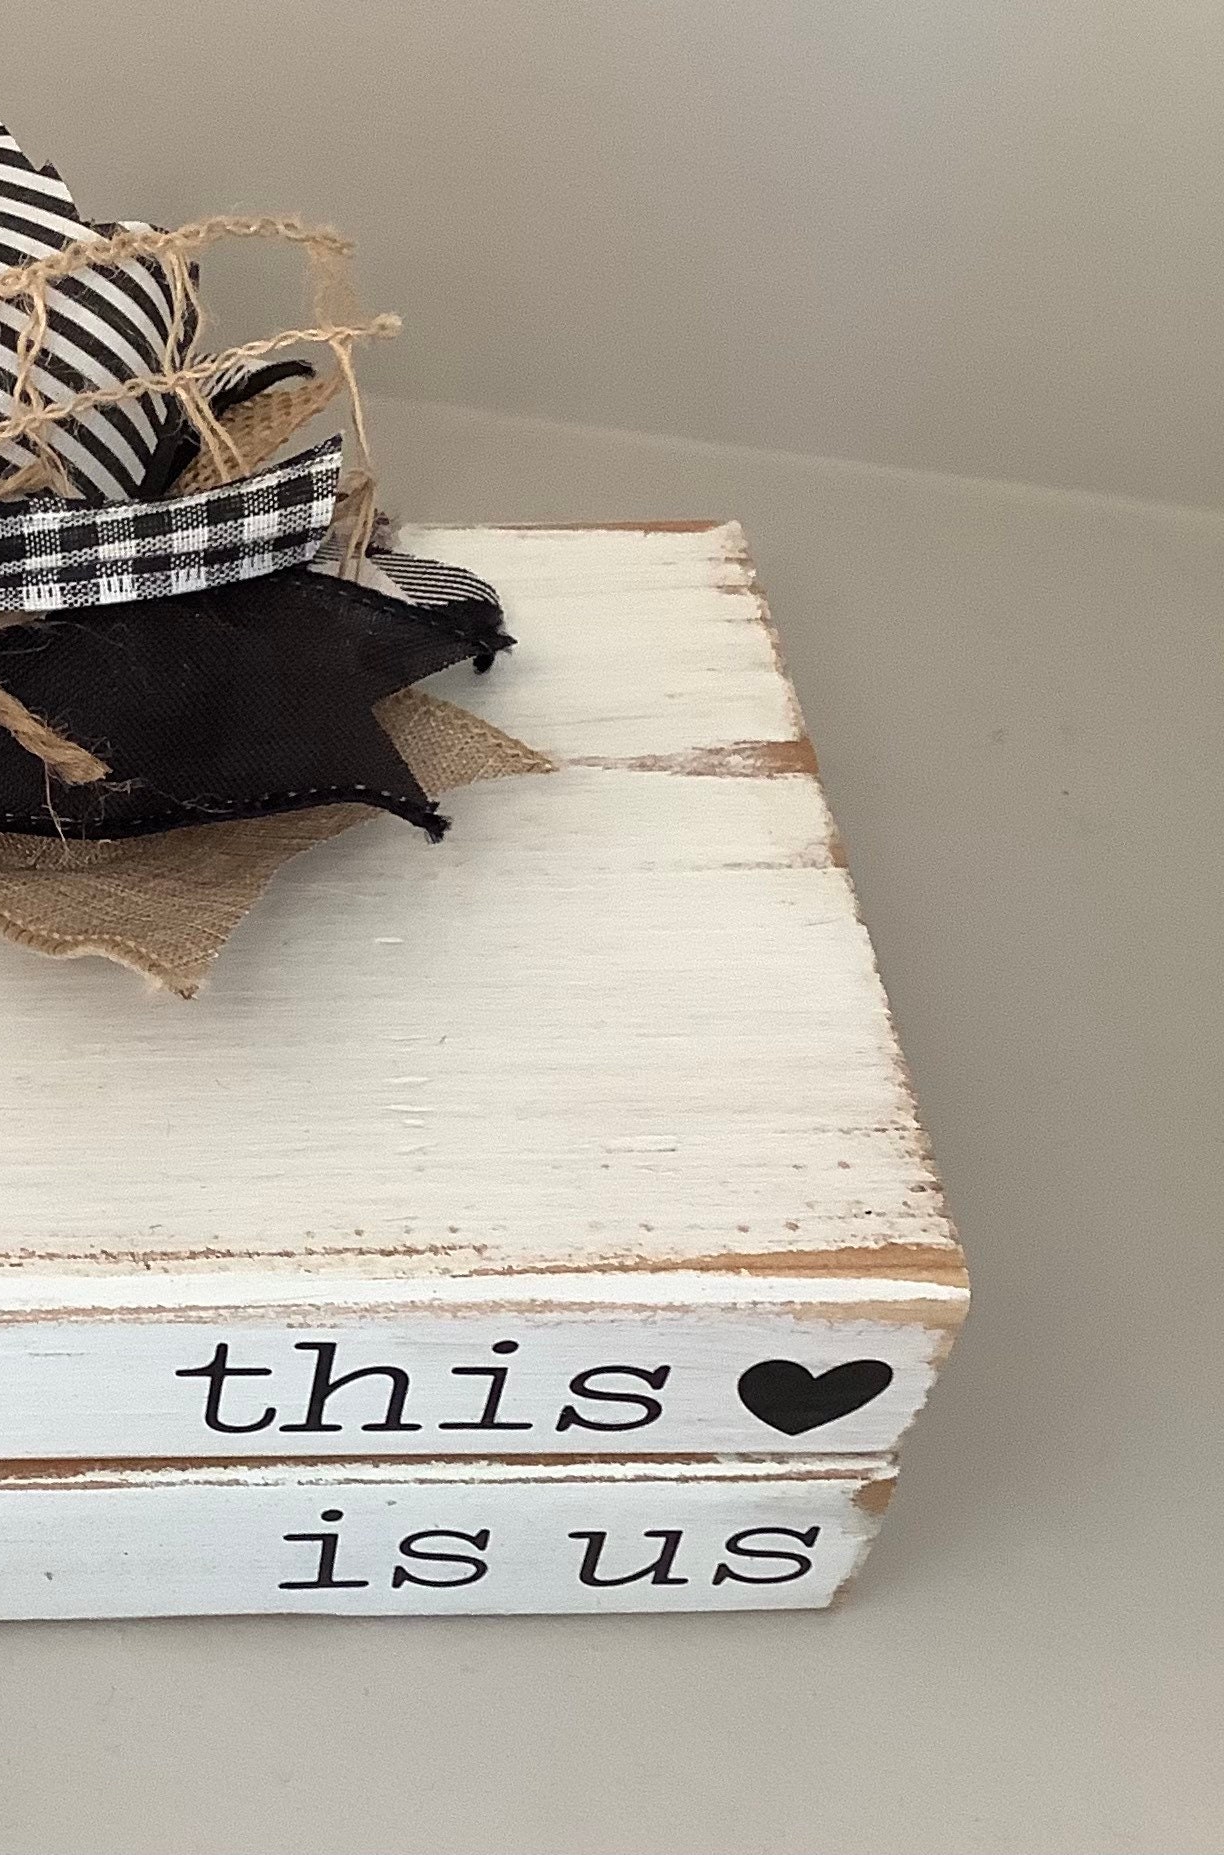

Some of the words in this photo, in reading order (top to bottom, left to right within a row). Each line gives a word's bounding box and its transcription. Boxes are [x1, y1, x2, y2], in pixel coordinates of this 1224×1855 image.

[175, 1340, 672, 1434] this
[278, 1508, 492, 1590] is
[568, 1526, 821, 1588] us
